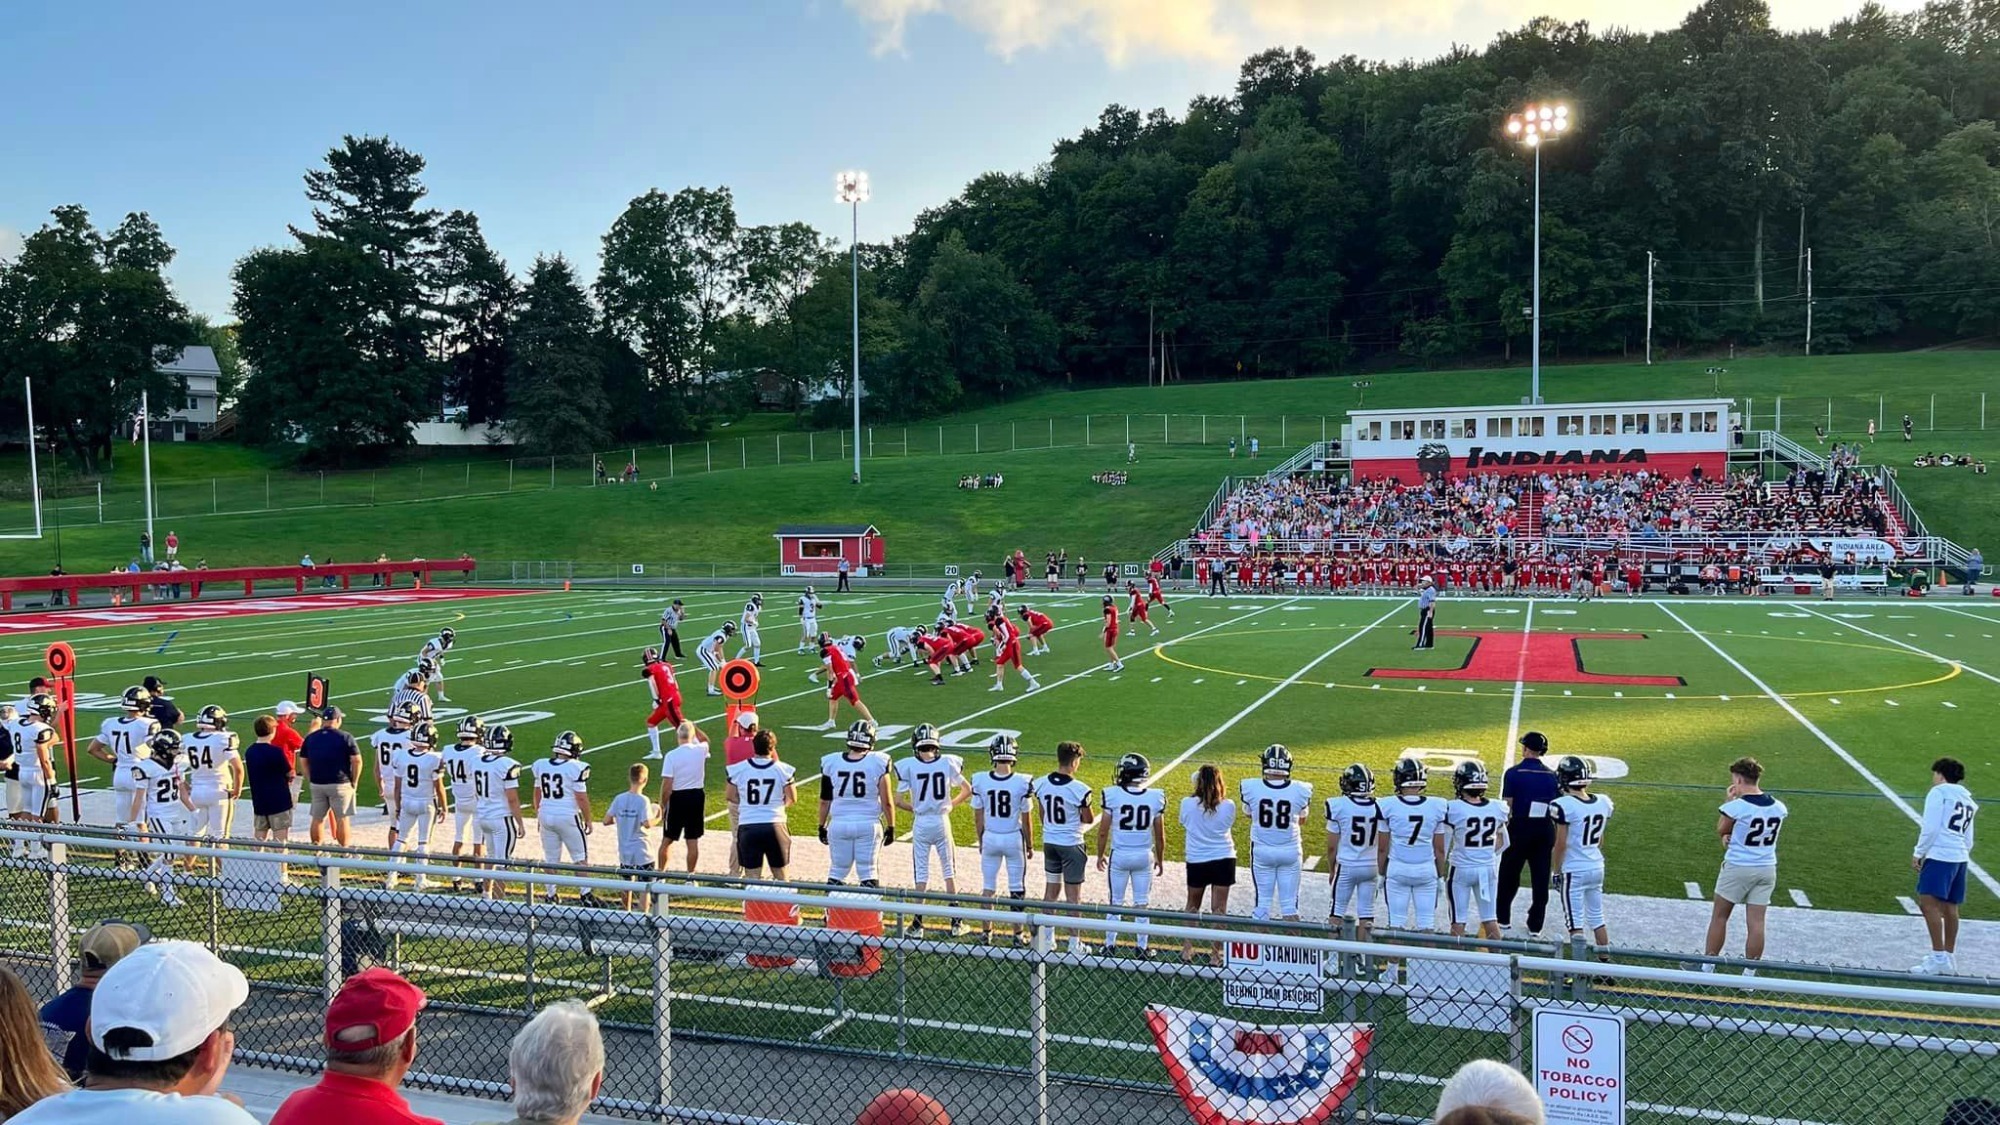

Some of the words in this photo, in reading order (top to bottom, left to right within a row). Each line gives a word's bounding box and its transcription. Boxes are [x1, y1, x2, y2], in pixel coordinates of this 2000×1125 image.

[1466, 447, 1648, 468] INDIANA
[634, 565, 641, 573] G
[785, 566, 795, 574] 10
[946, 566, 957, 574] 20
[1126, 566, 1137, 574] 30
[311, 679, 323, 708] 3
[14, 732, 22, 754] 8
[112, 730, 132, 755] 71
[188, 745, 213, 769] 64
[407, 764, 419, 788] 9
[448, 759, 467, 784] 14
[474, 770, 490, 798] 61
[156, 778, 180, 803] 25
[541, 772, 564, 800] 63
[746, 778, 776, 805] 67
[837, 771, 866, 798] 76
[917, 771, 946, 802] 70
[987, 789, 1012, 818] 18
[1044, 794, 1067, 825] 16
[1258, 799, 1291, 830] 68
[1119, 804, 1150, 831] 20
[1582, 813, 1604, 846] 12
[1948, 801, 1975, 834] 28
[1408, 815, 1424, 846] 7
[1464, 817, 1496, 847] 22
[1744, 817, 1781, 847] 23
[1231, 941, 1259, 960] NO
[1265, 944, 1317, 965] STANDING
[1229, 984, 1258, 999] BEHIND
[1283, 989, 1318, 1004] BENCHES
[1567, 1057, 1590, 1069] NO
[1540, 1070, 1617, 1088] TOBACCO
[1549, 1087, 1608, 1103] POLICY
